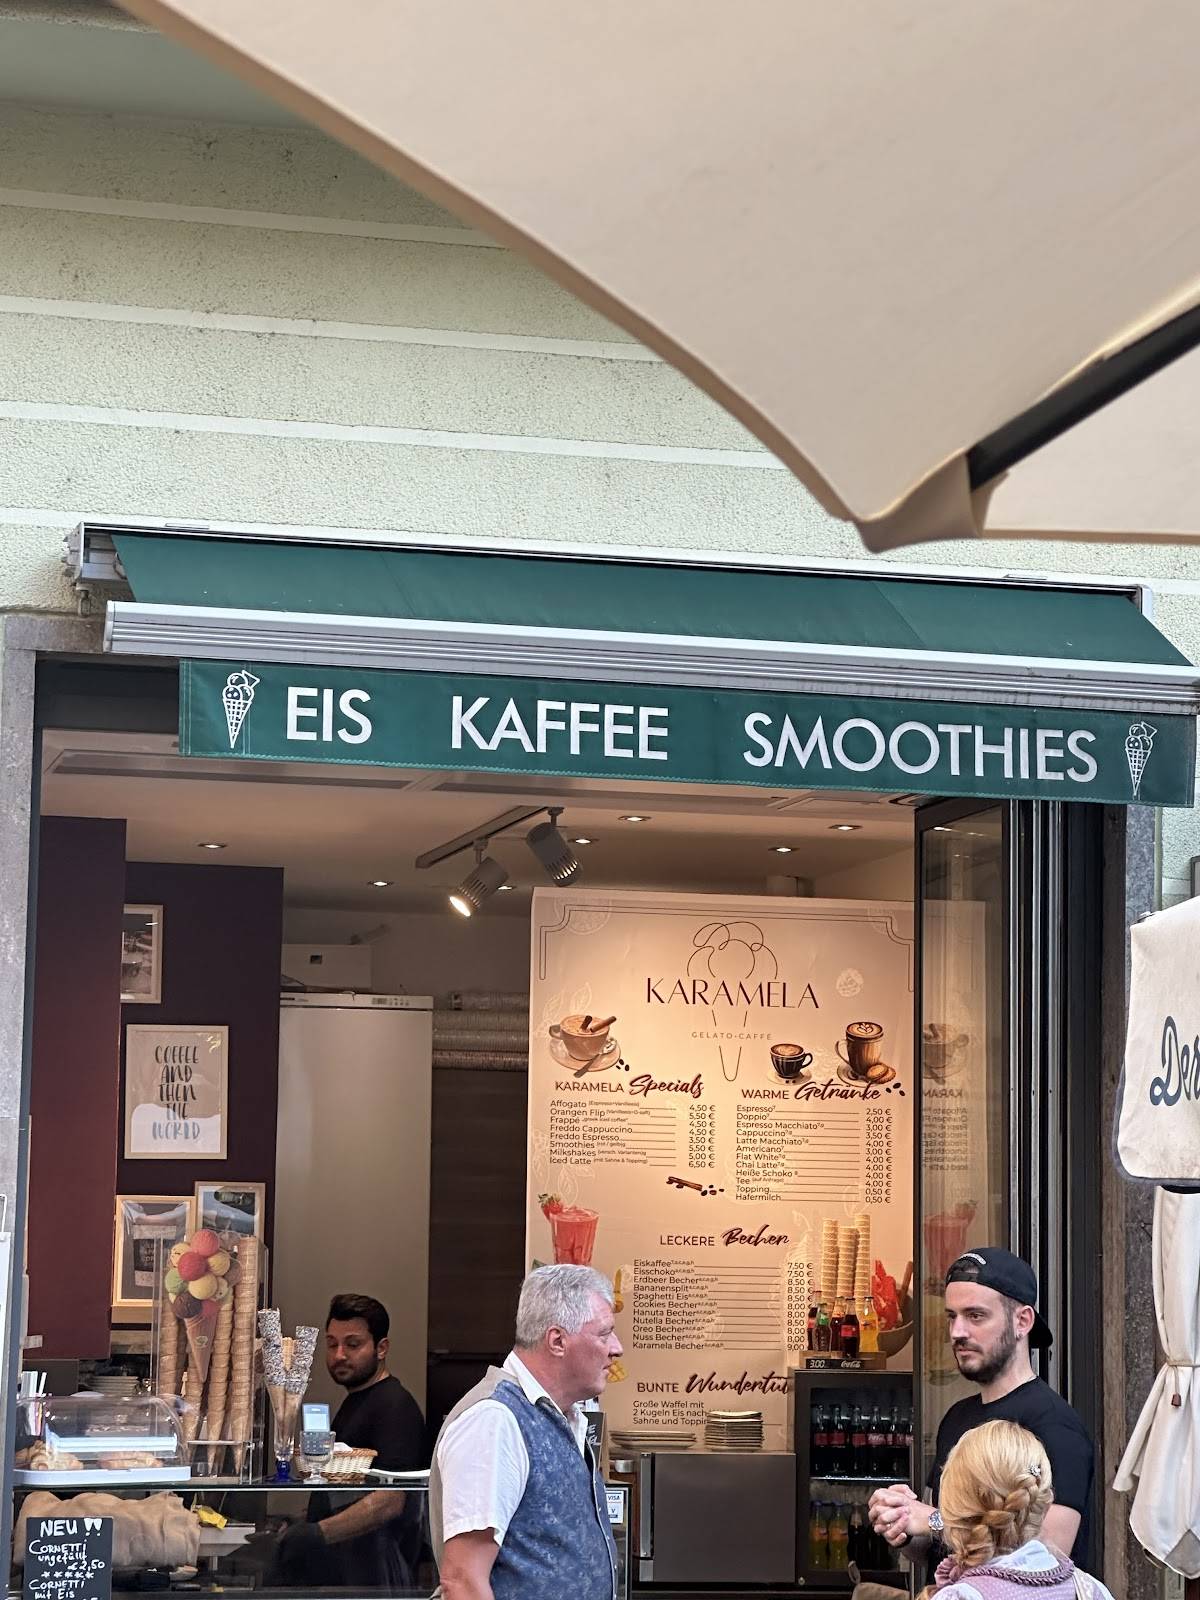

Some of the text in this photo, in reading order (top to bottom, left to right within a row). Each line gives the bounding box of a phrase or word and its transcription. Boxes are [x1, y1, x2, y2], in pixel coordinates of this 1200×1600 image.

[286, 686, 1098, 783] EIS KAFFEE SMOOTHIES
[647, 977, 819, 1009] KARAMELA
[155, 1046, 199, 1064] COFFEE
[162, 1064, 192, 1083] AND
[555, 1074, 704, 1098] KARAMELA Specials
[741, 1079, 881, 1100] WARME Getränke
[159, 1084, 196, 1102] THEN
[550, 1100, 586, 1108] Affogato
[166, 1103, 189, 1120] THE
[550, 1108, 587, 1117] Orangen
[550, 1124, 580, 1132] Freddo
[582, 1125, 632, 1133] Cappuccino
[737, 1121, 772, 1129] Espresso
[152, 1122, 200, 1140] WORLD
[550, 1132, 580, 1140] Freddo
[583, 1133, 619, 1142] Espresso
[736, 1169, 760, 1177] Heiße
[737, 1185, 770, 1194] Topping
[660, 1224, 789, 1247] LECKERE Becher
[788, 1262, 805, 1270] 7,50
[634, 1276, 667, 1284] Erdbeer
[633, 1292, 674, 1301] Spaghetti
[633, 1317, 663, 1325] Nutella
[788, 1319, 805, 1327] 8,50
[788, 1327, 805, 1335] 8,00
[637, 1382, 679, 1393] BUNTE
[641, 1409, 670, 1417] Kugeln
[40, 1520, 77, 1537] NEU
[35, 1591, 51, 1599] mit
[58, 1589, 75, 1599] Eis
